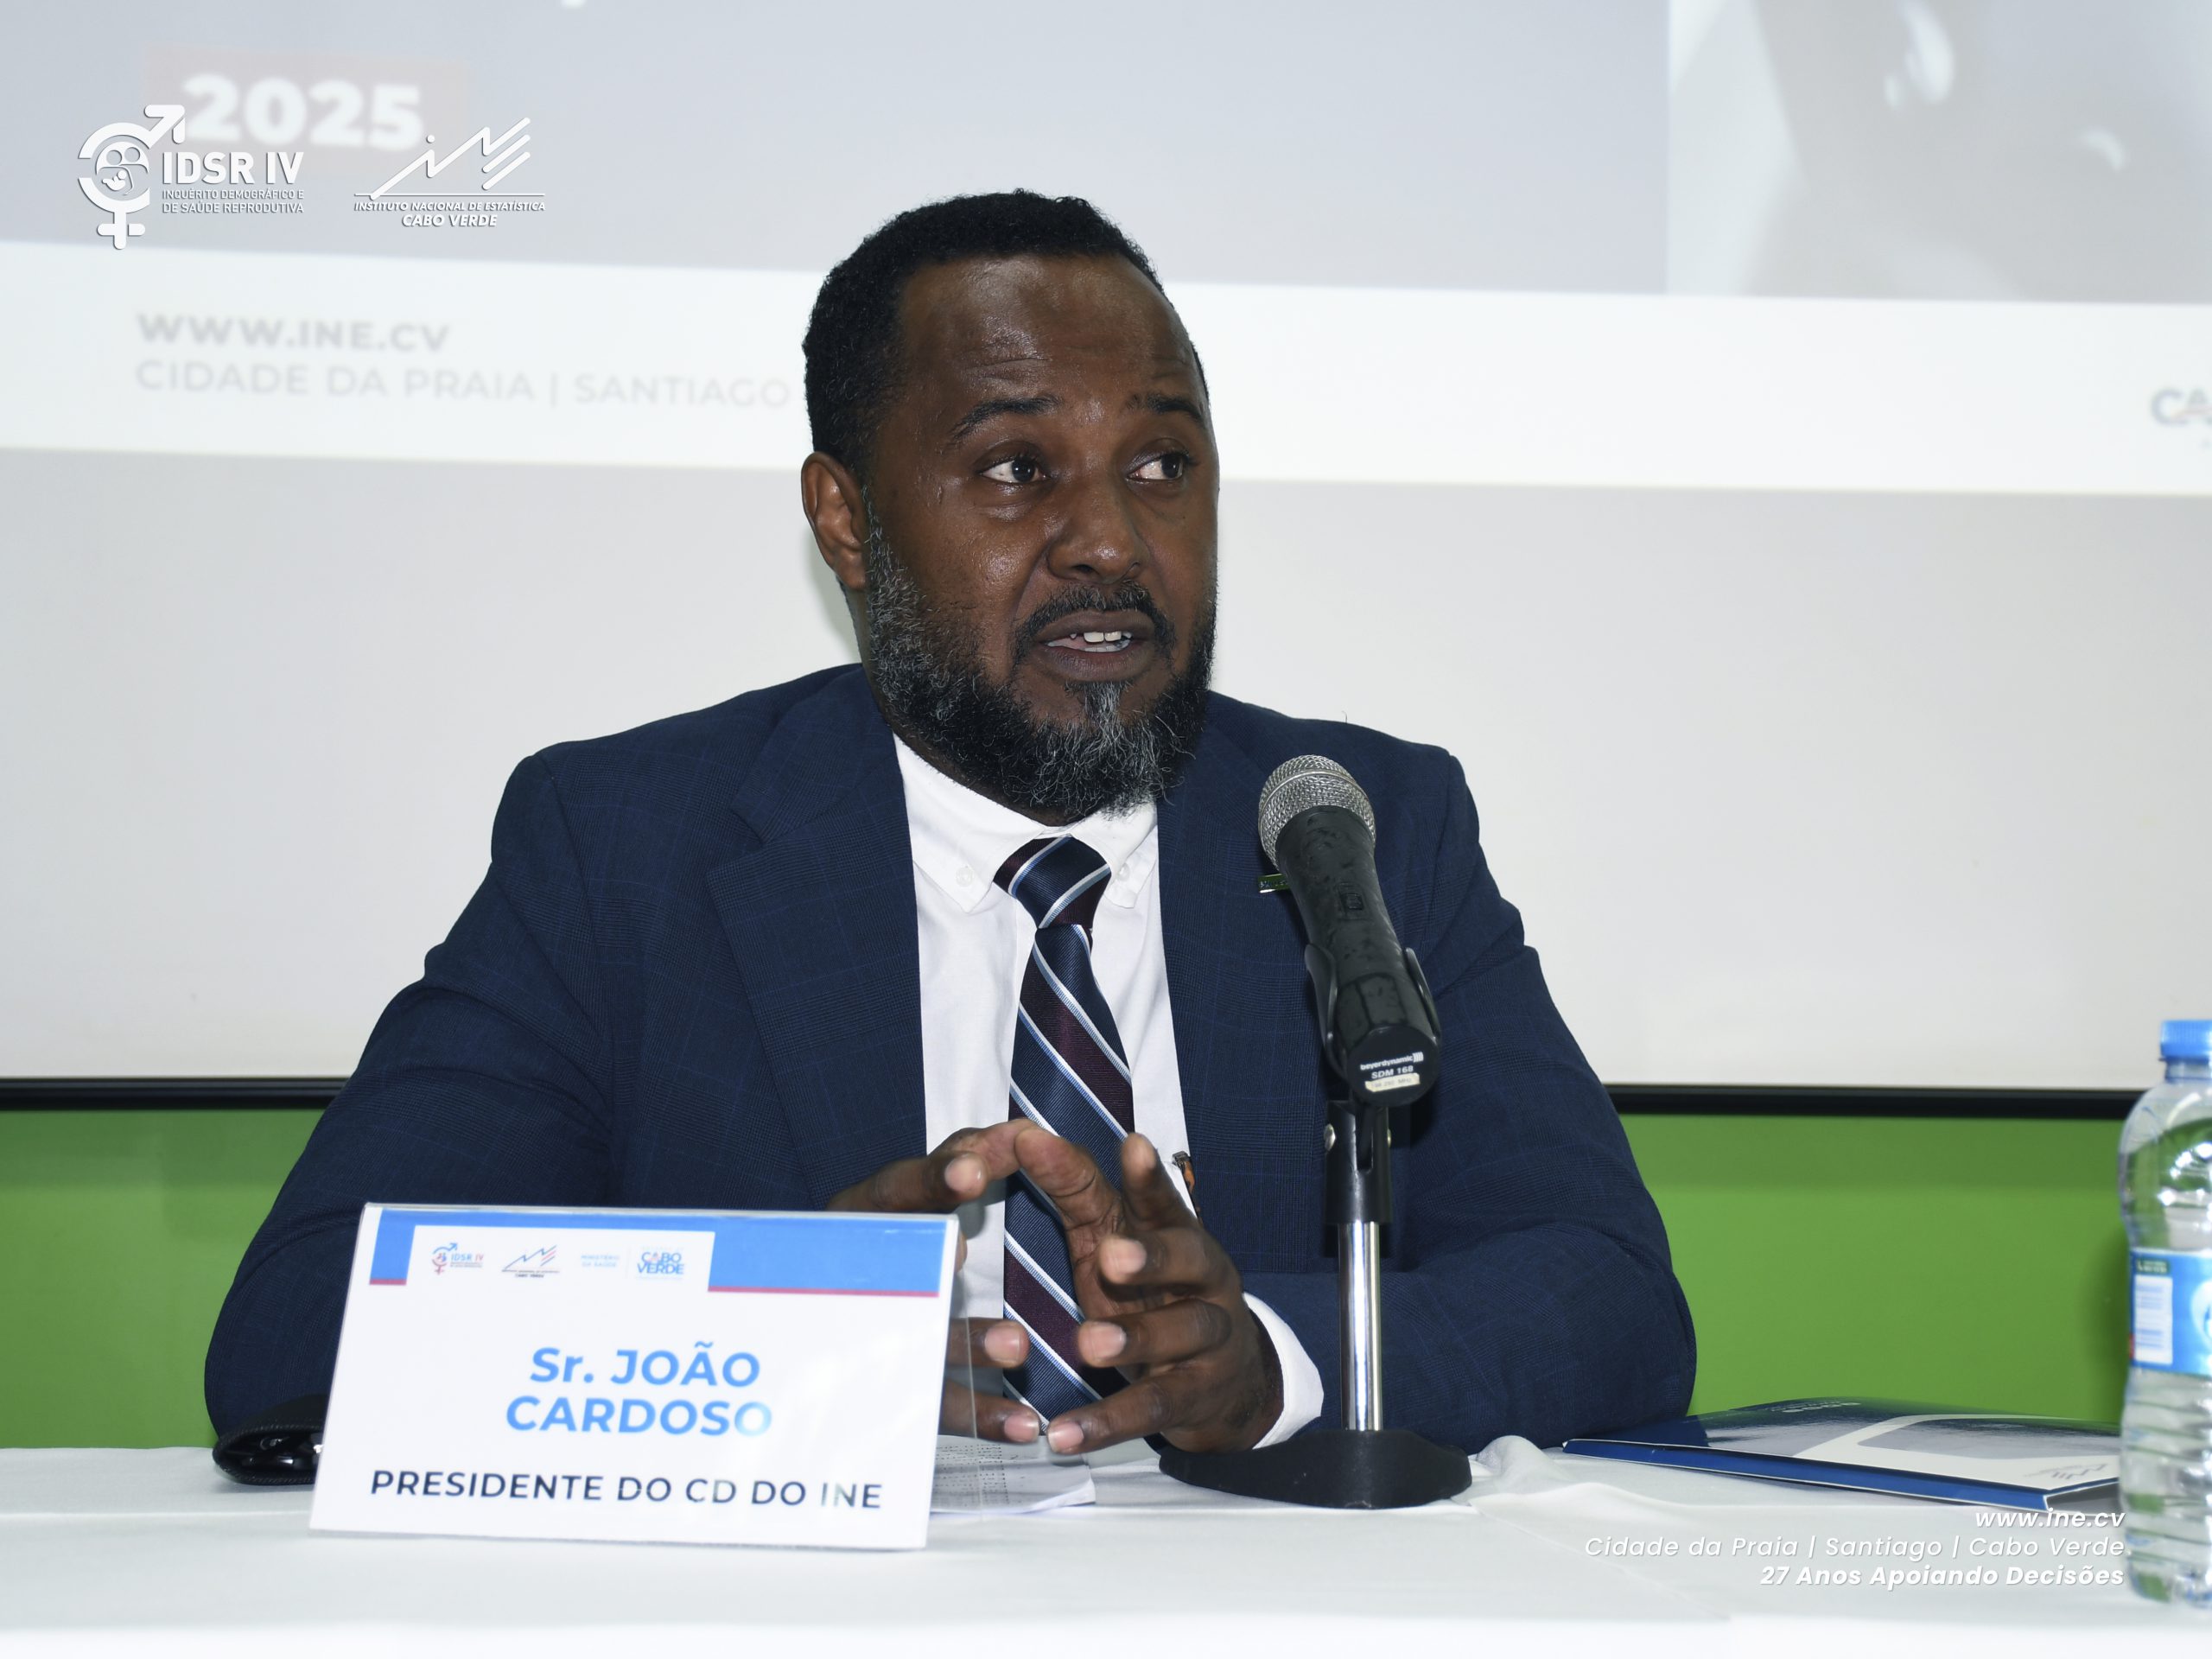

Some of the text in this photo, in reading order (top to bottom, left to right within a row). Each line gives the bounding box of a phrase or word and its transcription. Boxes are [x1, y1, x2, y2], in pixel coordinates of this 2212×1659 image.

[184, 73, 425, 151] 2025
[136, 312, 450, 354] WWW.INE.CV
[135, 358, 311, 396] CIDADE
[326, 365, 389, 397] DA
[404, 366, 536, 403] PRAIA
[573, 372, 791, 409] SANTIAGO
[1371, 1065, 1414, 1079] SDM 168
[637, 1262, 685, 1275] VERDE
[640, 1251, 683, 1263] CABO
[530, 1341, 760, 1388] Sr. JOÃO
[505, 1395, 773, 1437] CARDOSO
[370, 1470, 882, 1509] PRESIDENTE DO CD DO INE
